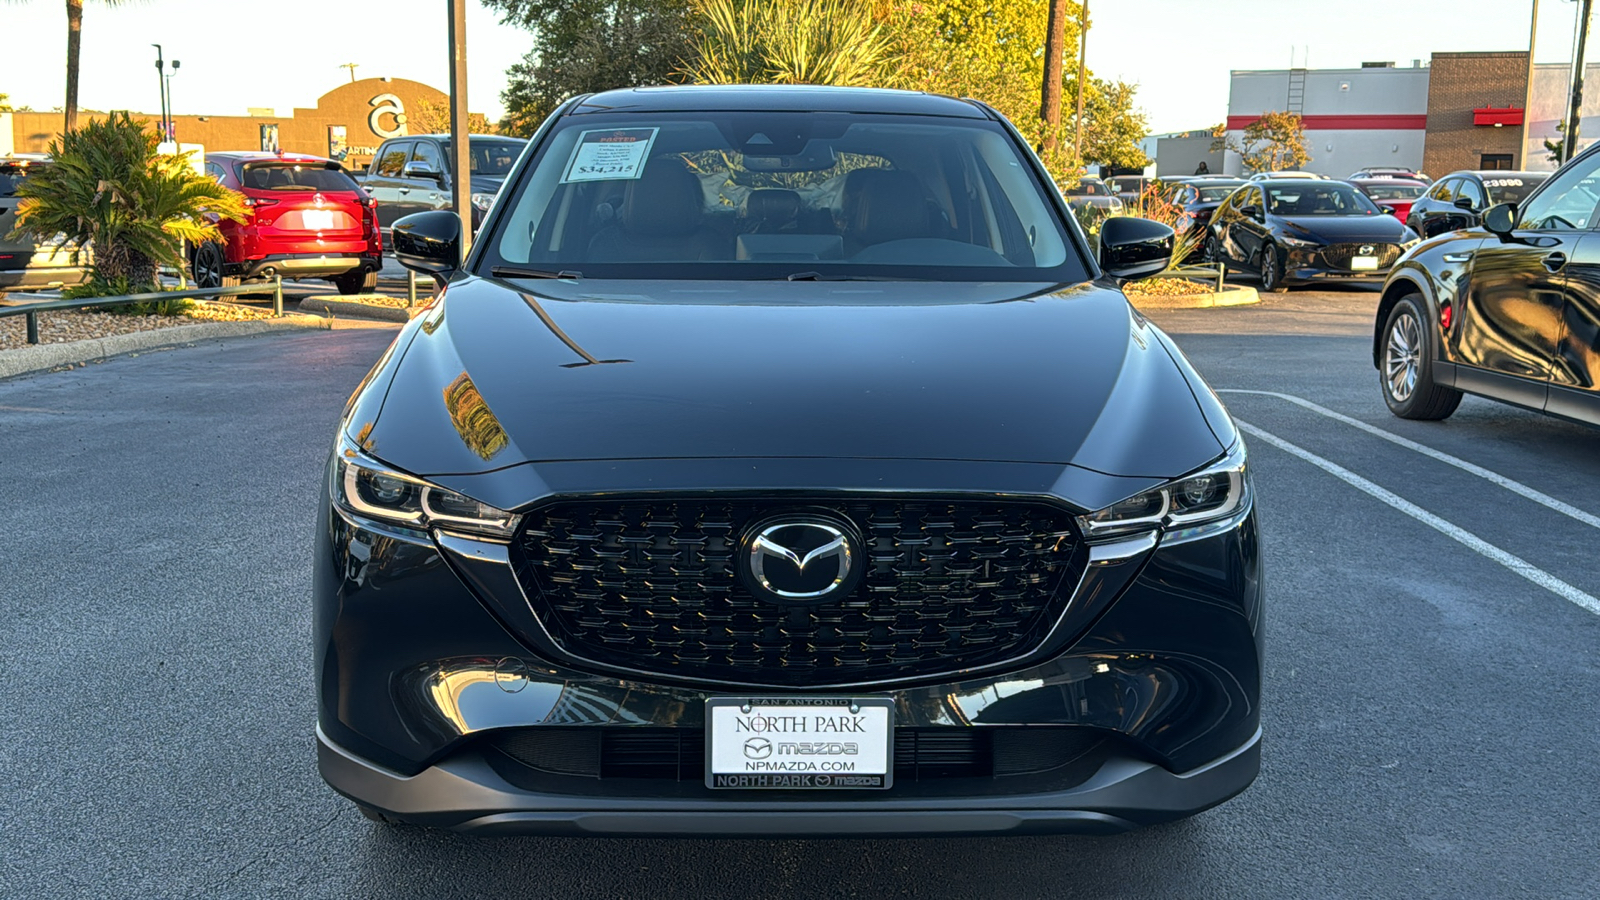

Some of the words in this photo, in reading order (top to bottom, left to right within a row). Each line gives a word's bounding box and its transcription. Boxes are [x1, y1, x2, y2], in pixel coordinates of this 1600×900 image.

[578, 165, 633, 173] $34,215
[735, 716, 807, 732] NORTH
[815, 716, 866, 732] PARK
[745, 761, 855, 771] NPMAZDA.COM
[717, 775, 768, 786] NORTH
[772, 775, 811, 786] PARK
